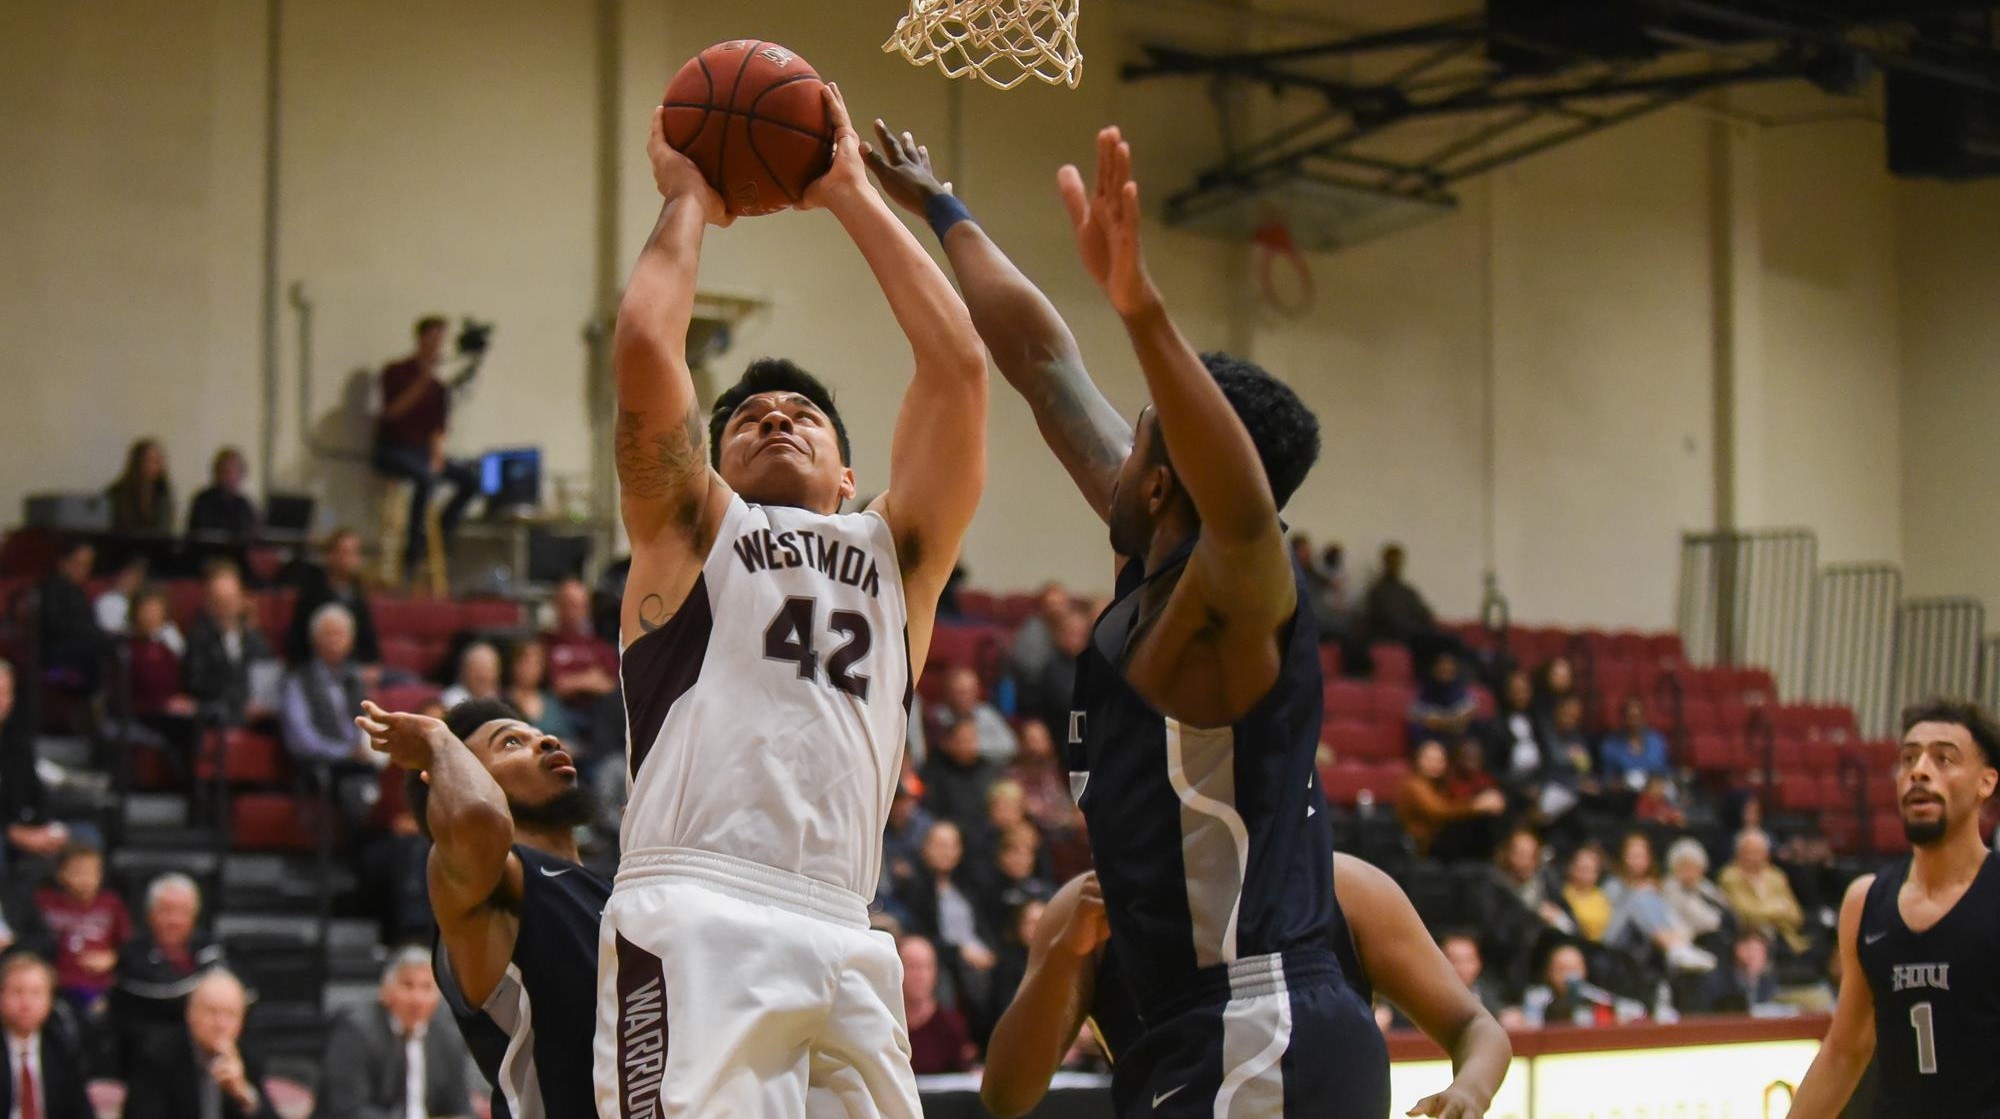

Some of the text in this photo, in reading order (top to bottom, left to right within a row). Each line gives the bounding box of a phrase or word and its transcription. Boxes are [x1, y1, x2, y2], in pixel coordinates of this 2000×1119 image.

[733, 528, 879, 598] WESTMON
[762, 595, 872, 705] 42
[1910, 1002, 1938, 1074] 1
